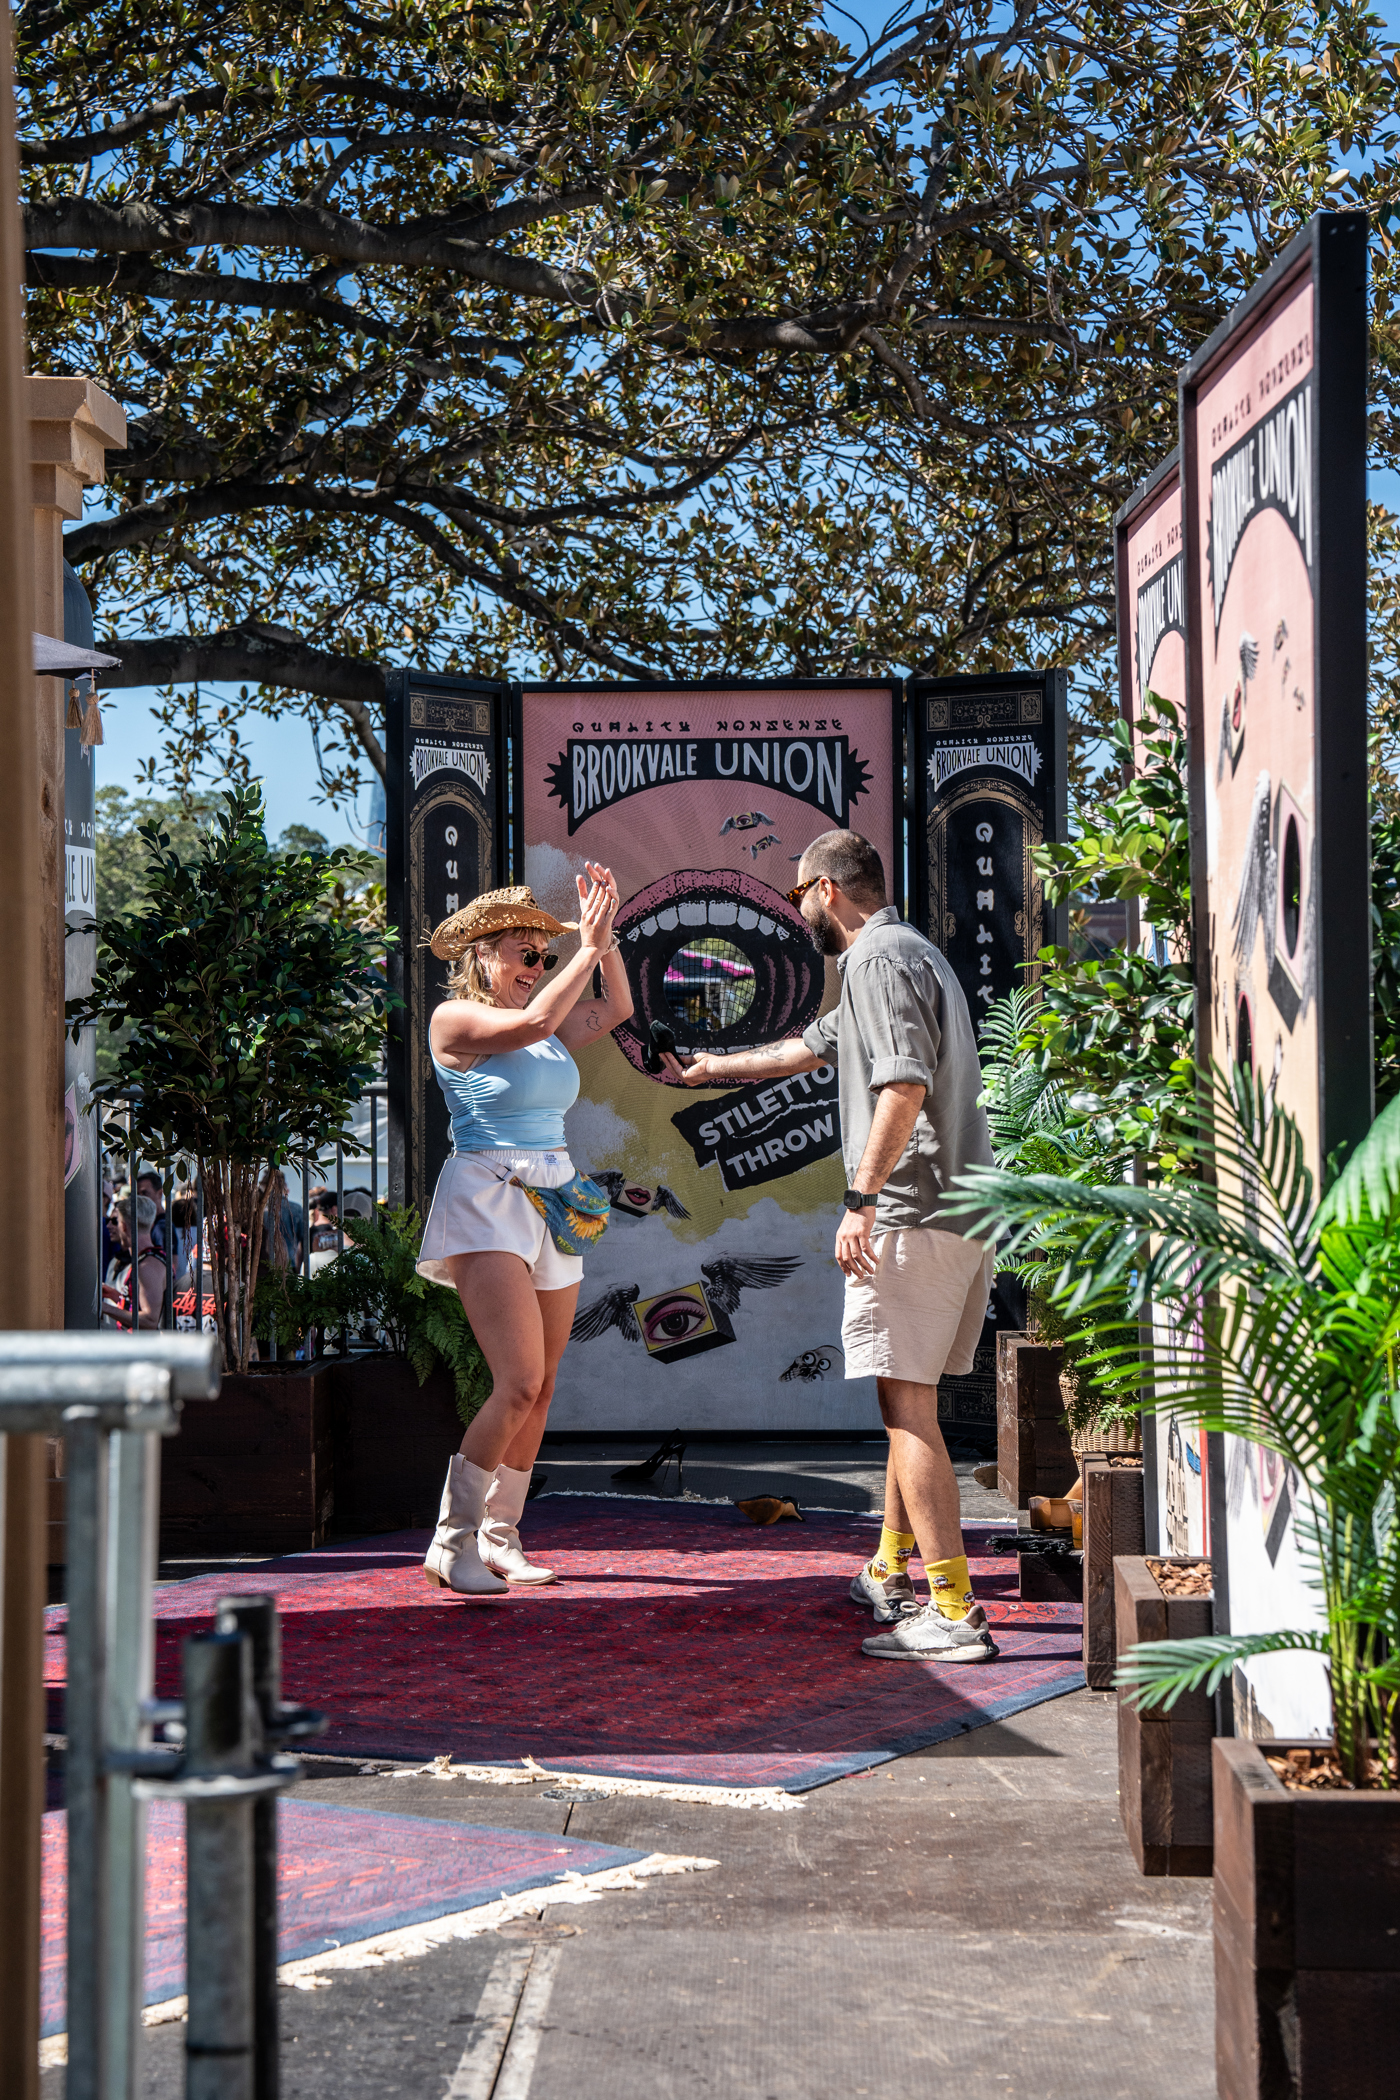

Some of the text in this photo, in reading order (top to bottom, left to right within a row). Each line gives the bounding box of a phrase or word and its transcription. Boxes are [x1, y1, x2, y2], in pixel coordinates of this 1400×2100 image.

[1259, 385, 1312, 567] UNION
[1166, 557, 1185, 628] UNI
[572, 719, 843, 733] QUALITY NONSENSE
[416, 748, 485, 788] BROOKVALE UNION
[573, 741, 843, 820] BROOKVALE UNION
[936, 745, 1032, 784] BROOKVALE UNION
[698, 1064, 835, 1146] STILETTO
[726, 1113, 834, 1178] THROW
